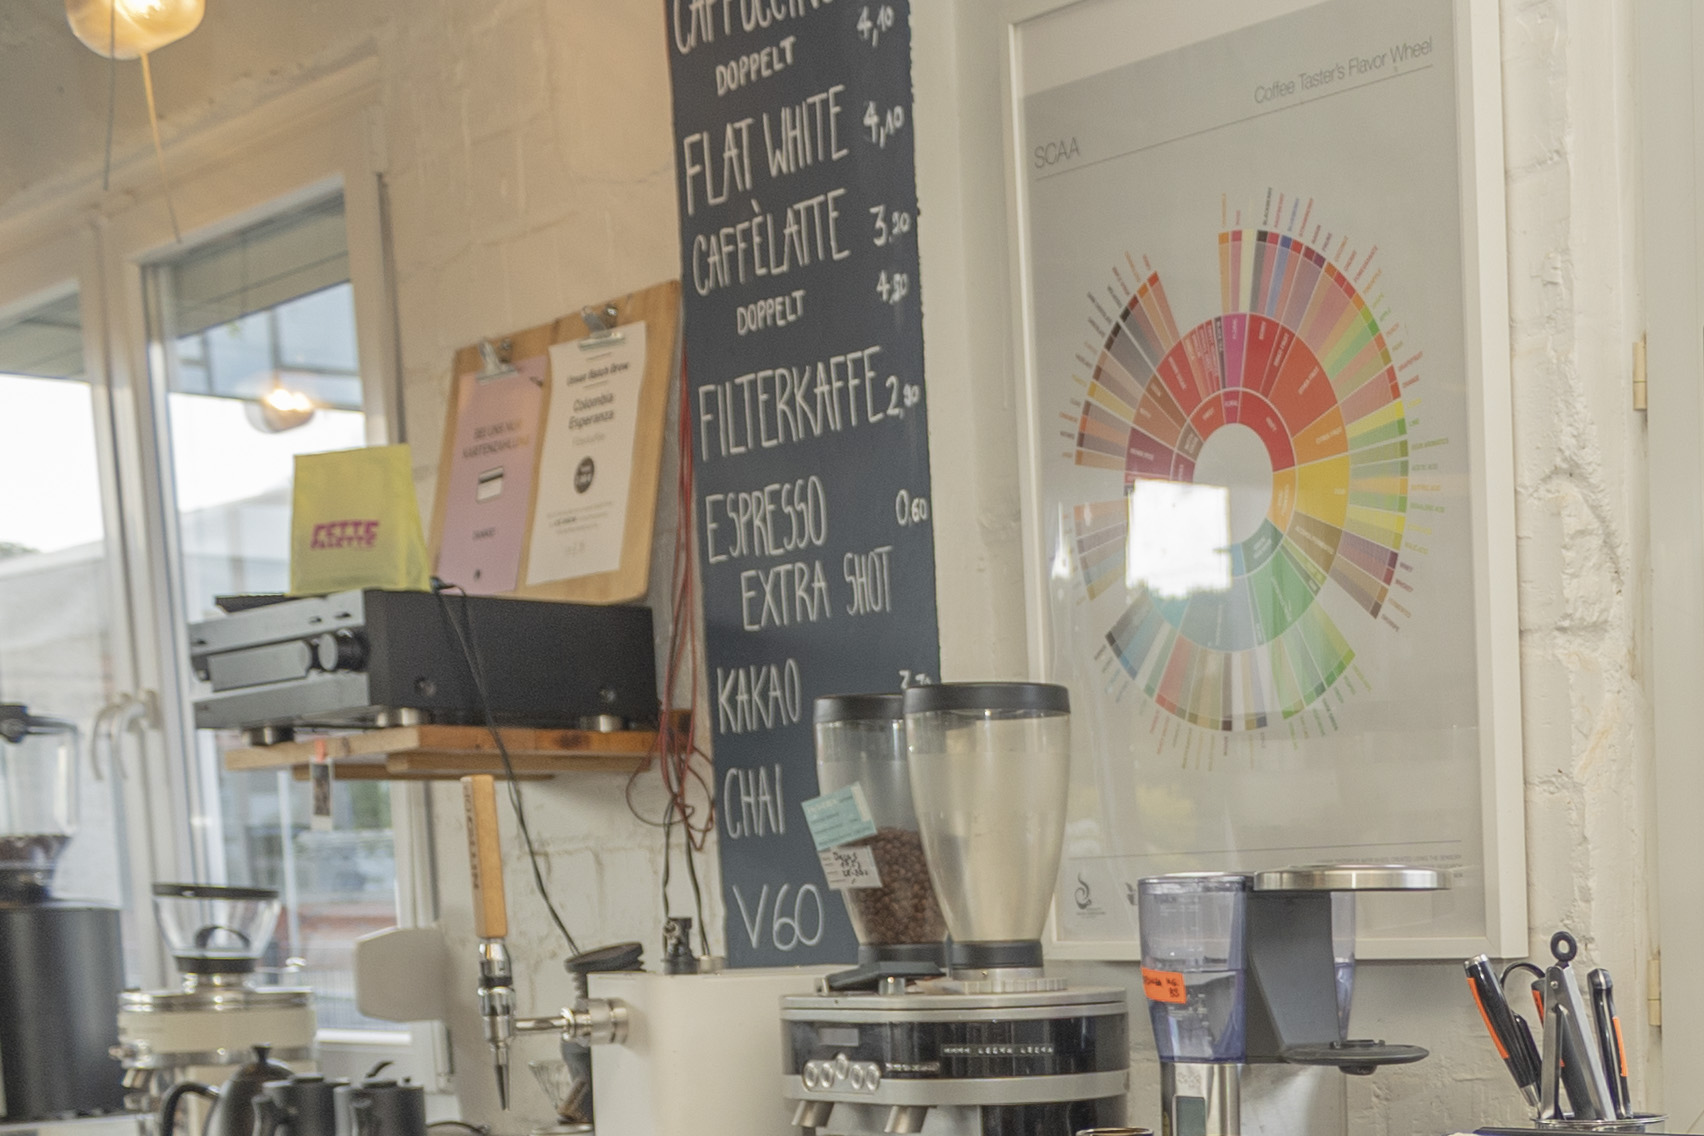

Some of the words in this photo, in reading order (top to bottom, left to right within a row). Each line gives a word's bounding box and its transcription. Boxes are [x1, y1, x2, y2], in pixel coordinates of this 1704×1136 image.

[715, 35, 796, 96] DOPPELT
[1254, 80, 1296, 104] Coffee
[1298, 62, 1345, 91] Taster's
[1349, 51, 1387, 76] Flavor
[1389, 35, 1433, 63] Wheel
[683, 118, 753, 216] FLAT
[763, 85, 849, 177] WHITE
[1033, 137, 1081, 170] SCAA
[737, 290, 805, 335] DOPPELT
[699, 346, 885, 461] FILTERKAFFE
[706, 475, 827, 563] ESPRESSO
[741, 560, 830, 631] EXTRA
[844, 545, 893, 617] SHOT
[717, 658, 801, 734] KAKAO
[723, 764, 785, 839] CHAI
[732, 883, 825, 950] V60
